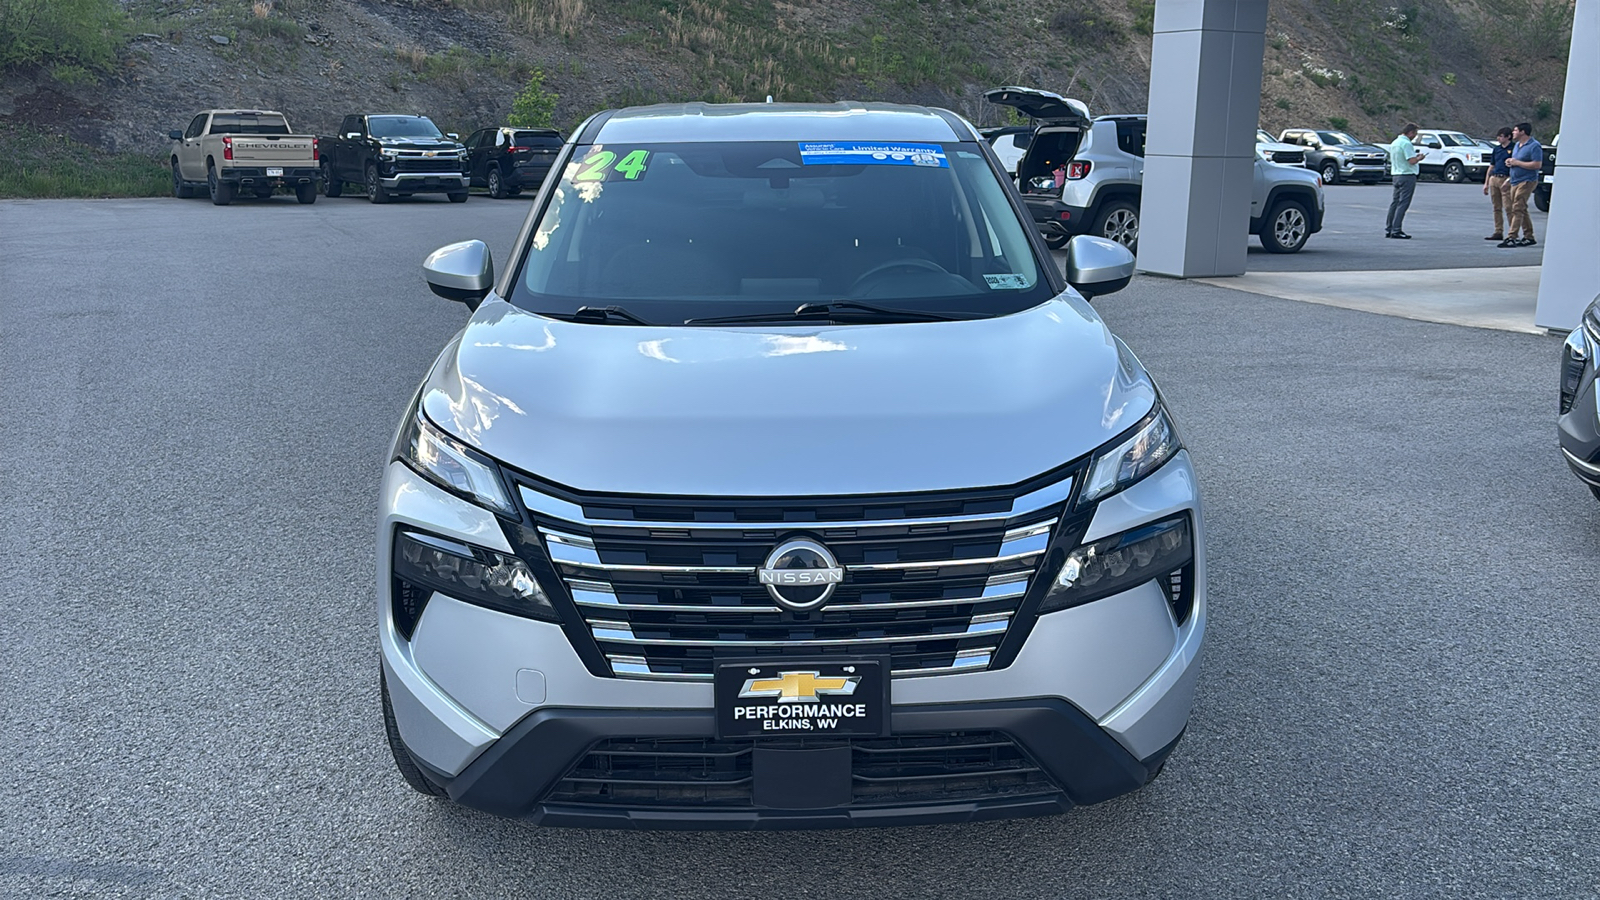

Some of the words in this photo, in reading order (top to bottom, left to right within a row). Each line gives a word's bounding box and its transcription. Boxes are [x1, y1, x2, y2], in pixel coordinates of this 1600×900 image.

[890, 146, 937, 154] Warranty
[576, 149, 651, 181] 24
[761, 571, 842, 583] NISSAN
[734, 704, 866, 720] PERFORMANCE
[763, 718, 814, 731] ELKINS,
[817, 718, 838, 730] WV
